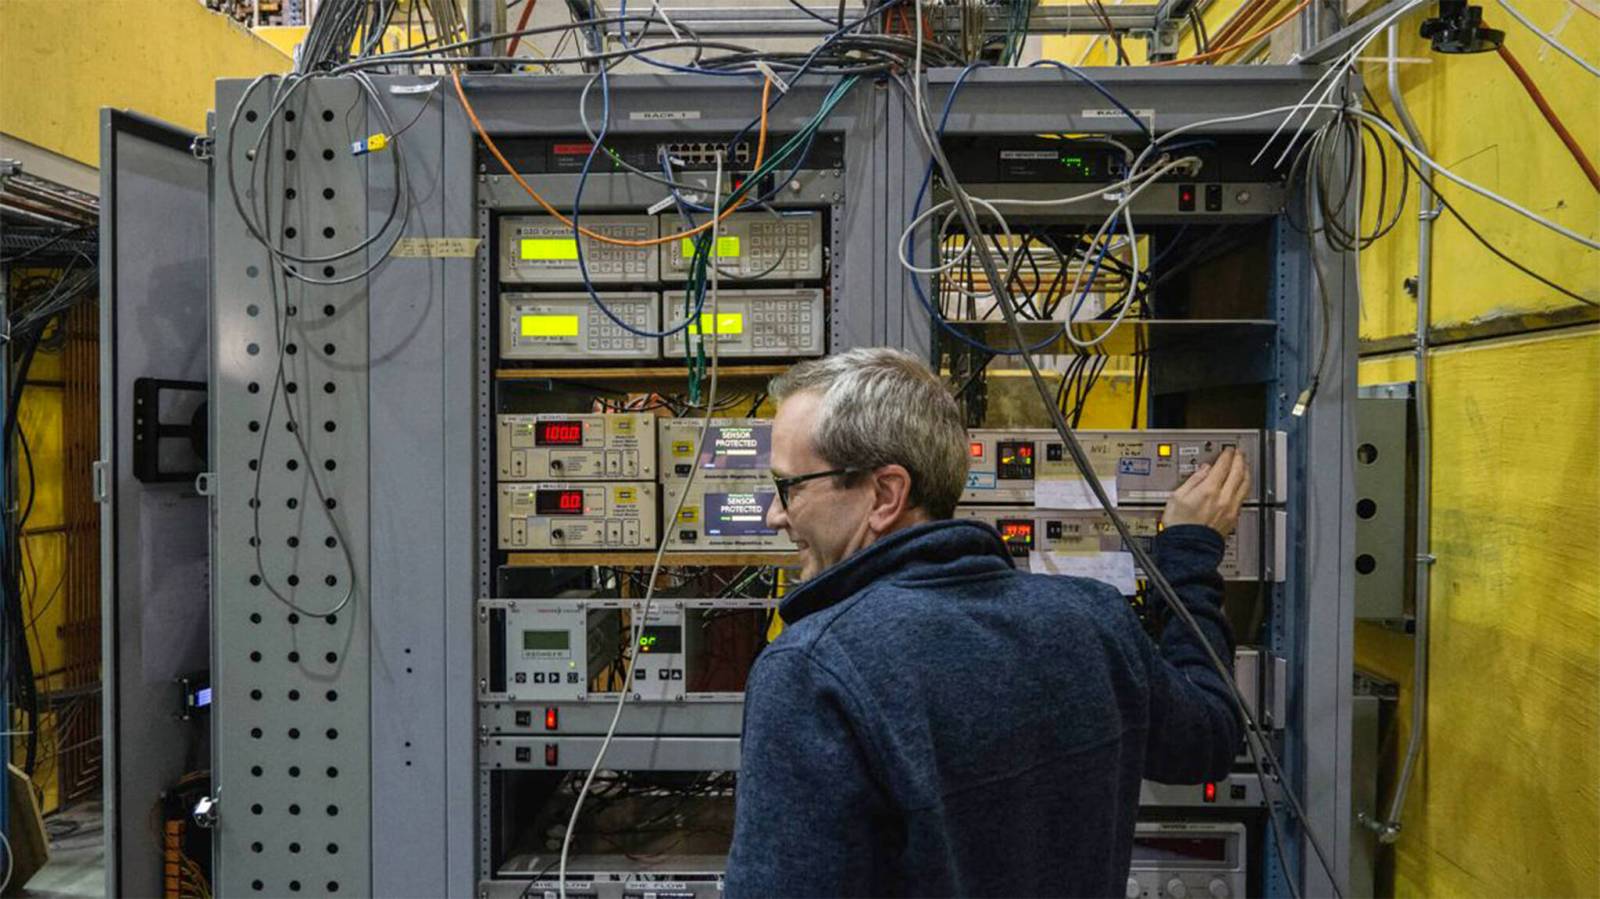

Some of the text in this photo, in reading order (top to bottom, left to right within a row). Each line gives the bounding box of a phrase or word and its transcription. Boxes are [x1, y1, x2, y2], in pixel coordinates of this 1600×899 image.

[721, 430, 750, 438] SENSOR
[715, 440, 758, 448] PROTECTED
[720, 506, 763, 514] PROTECTED
